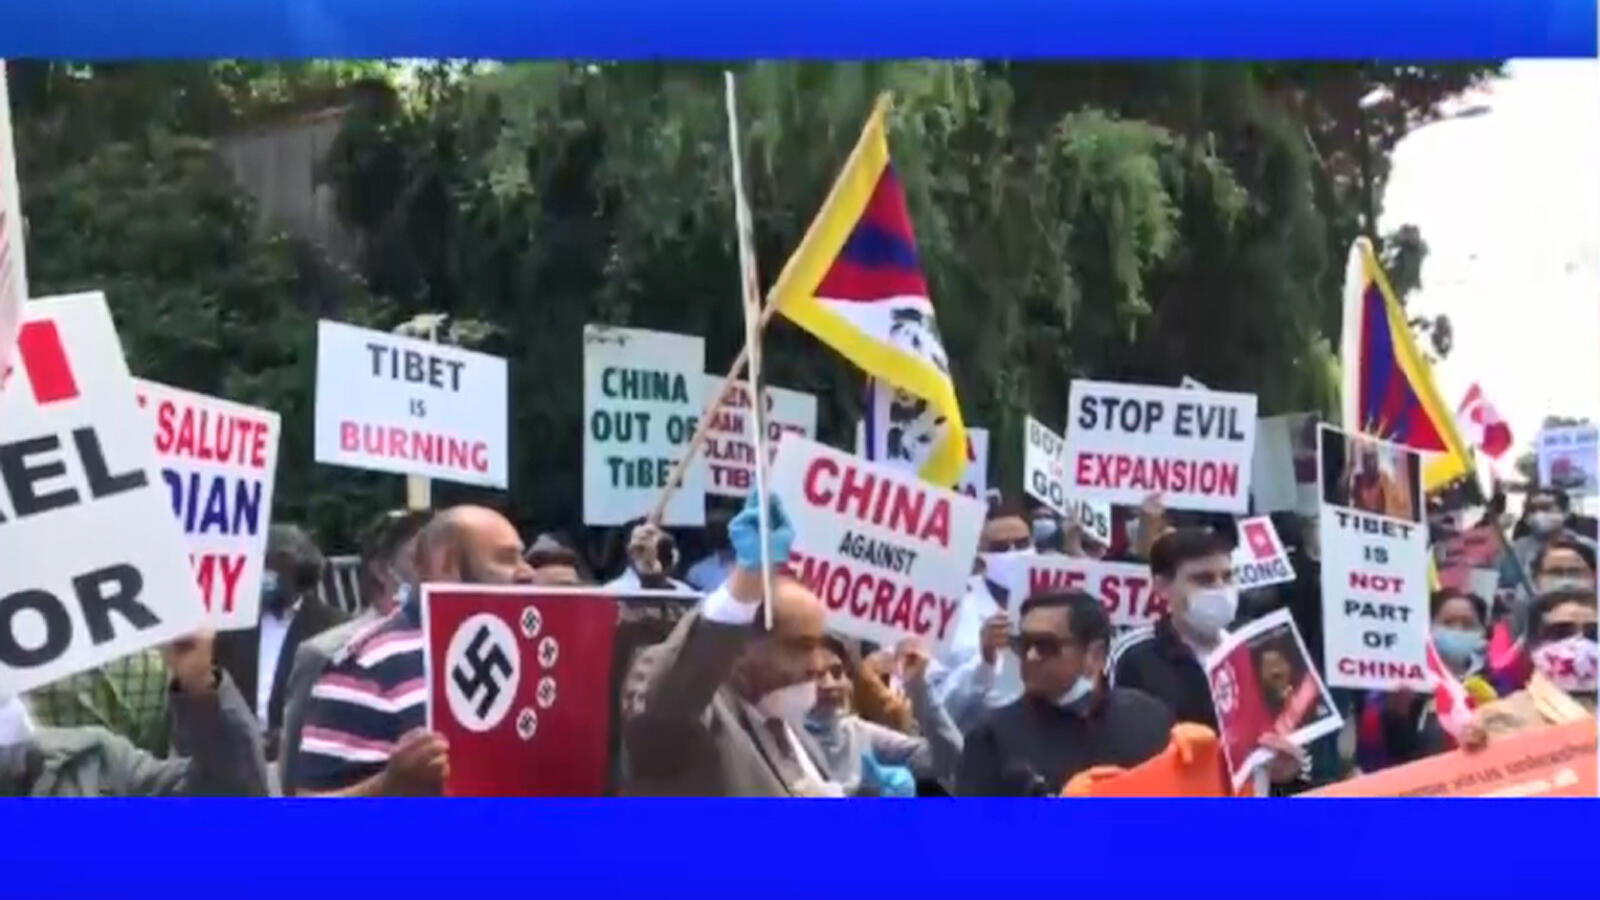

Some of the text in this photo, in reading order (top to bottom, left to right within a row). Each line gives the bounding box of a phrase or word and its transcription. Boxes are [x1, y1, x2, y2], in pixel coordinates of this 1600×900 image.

[366, 343, 466, 392] TIBET
[602, 367, 689, 404] CHINA
[409, 398, 427, 418] IS
[591, 411, 651, 443] OUT
[1078, 396, 1245, 441] STOP EVIL
[154, 401, 269, 468] SALUTE
[339, 420, 489, 474] BURNING
[0, 427, 149, 524] EL
[1076, 452, 1240, 497] EXPANSION
[803, 457, 951, 548] CHINA
[1032, 470, 1108, 538] GODS
[1336, 511, 1415, 540] TIBET
[838, 530, 918, 576] AGAINST
[1363, 546, 1389, 564] IS
[1349, 570, 1405, 594] NOT
[1344, 599, 1412, 623] PART
[1362, 630, 1398, 649] OF
[1337, 657, 1424, 681] CHINA
